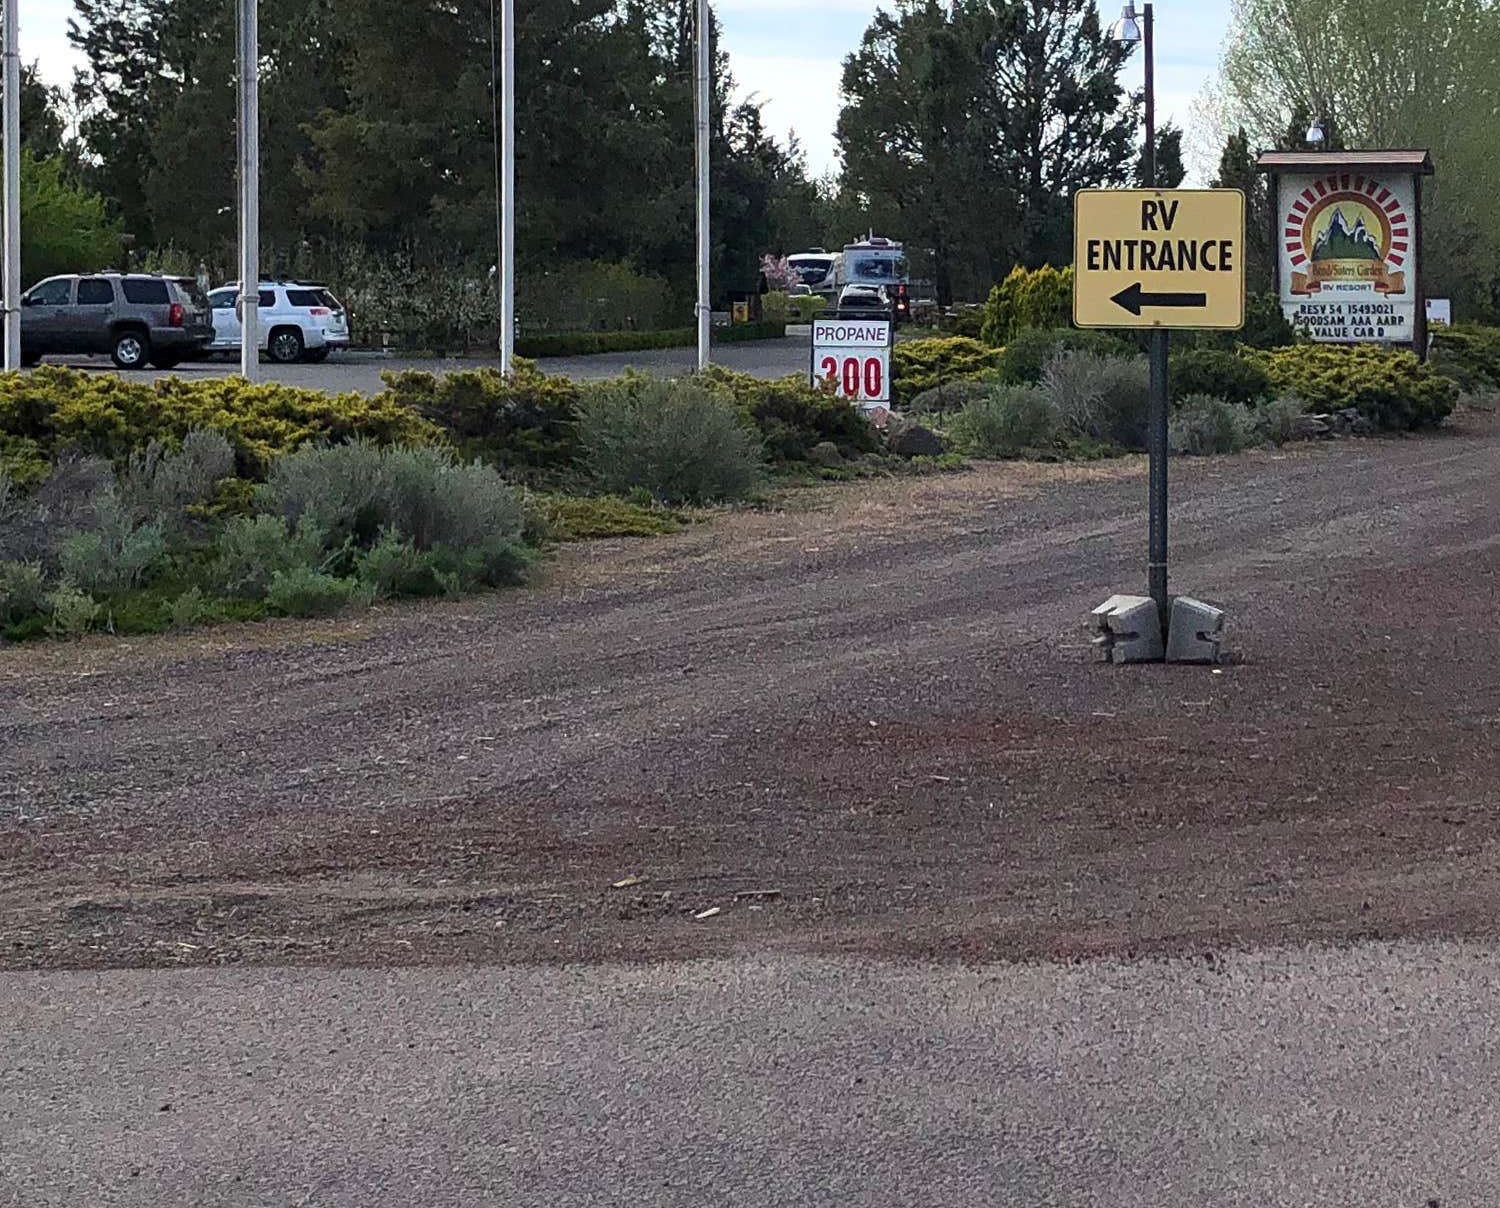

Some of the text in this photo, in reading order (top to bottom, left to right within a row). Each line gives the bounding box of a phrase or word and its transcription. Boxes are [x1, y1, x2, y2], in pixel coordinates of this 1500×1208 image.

[1141, 200, 1179, 231] RV
[1087, 240, 1233, 271] ENTRANCE
[1300, 304, 1326, 314] RESV
[1350, 316, 1372, 326] AAA
[1376, 316, 1404, 325] AARP
[816, 326, 886, 341] PROPANE
[1314, 327, 1348, 337] VALUE
